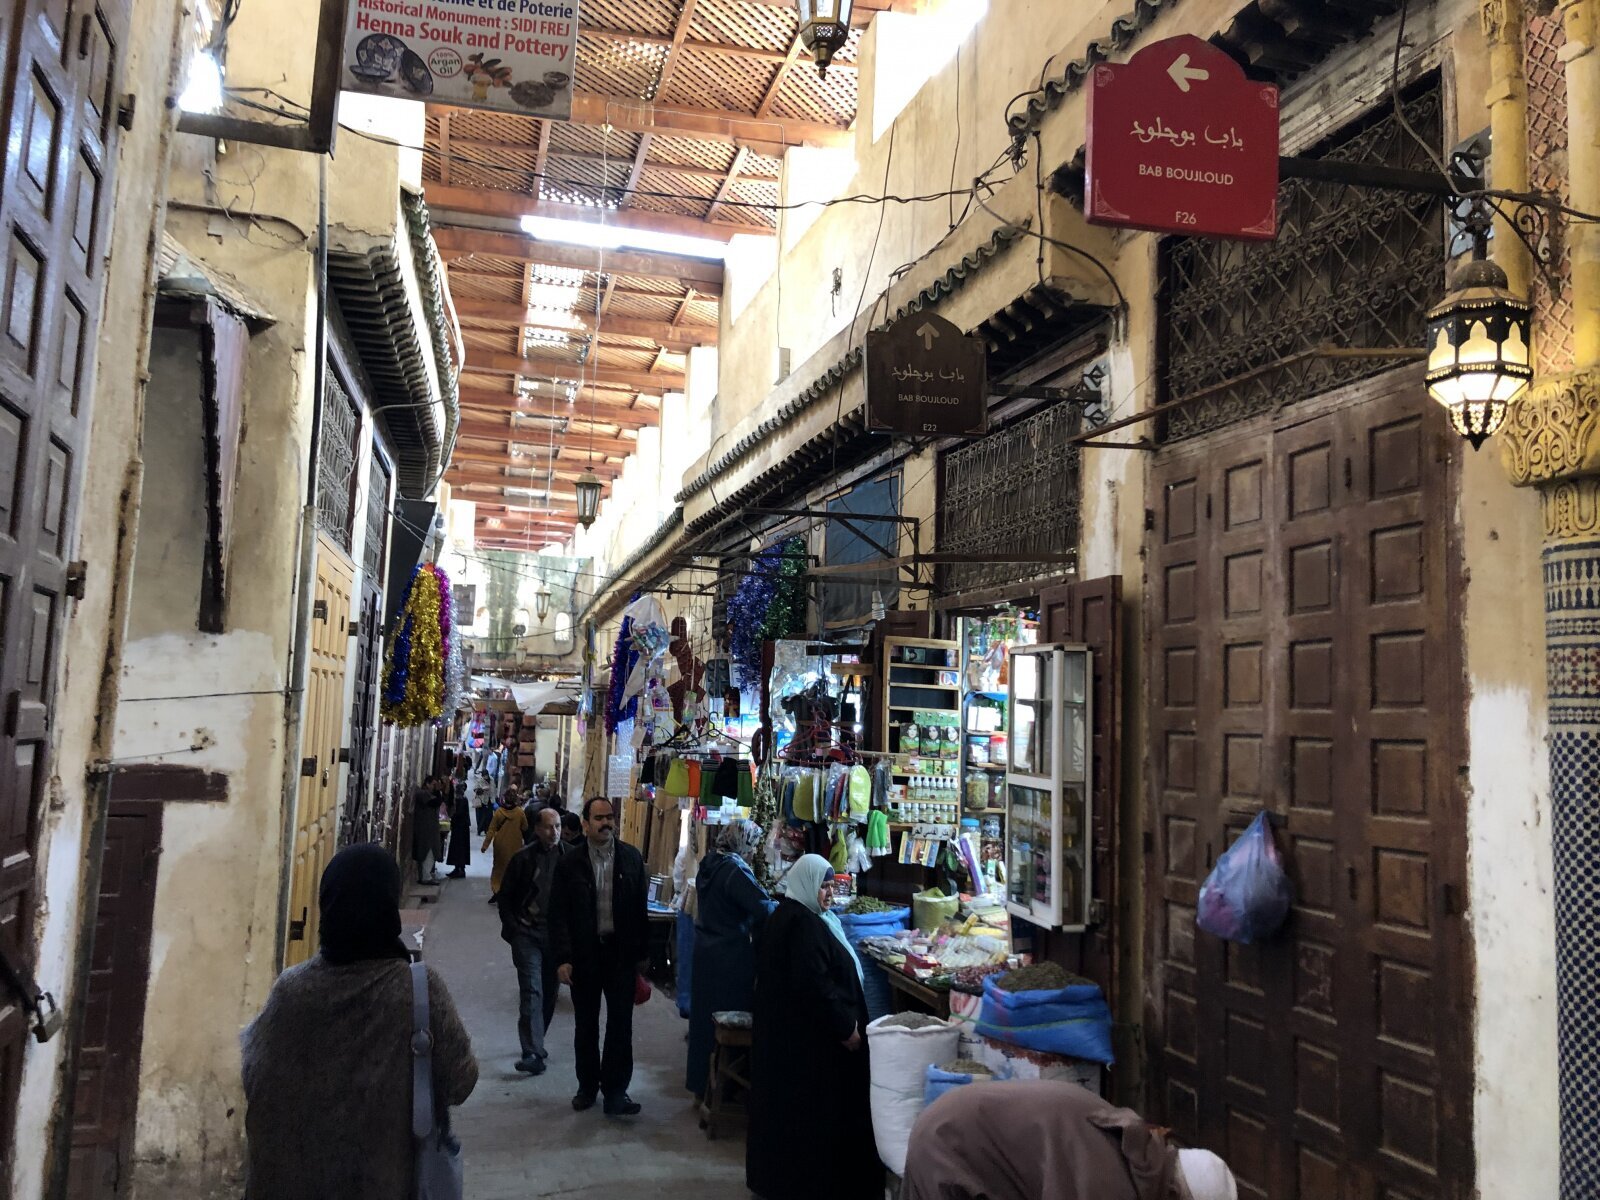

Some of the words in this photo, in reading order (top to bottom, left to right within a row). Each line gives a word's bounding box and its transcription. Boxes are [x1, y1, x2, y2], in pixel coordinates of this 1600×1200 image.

[358, 0, 423, 18] Historical
[425, 5, 501, 29] Monument
[511, 17, 537, 34] SIDI
[540, 21, 570, 37] FREJ
[478, 0, 494, 9] et
[497, 0, 516, 12] de
[519, 0, 573, 19] Poterie
[356, 11, 415, 37] Henna
[419, 21, 462, 44] Souk
[466, 32, 500, 50] and
[504, 33, 569, 62] Pottery
[431, 58, 460, 66] Argan
[439, 66, 453, 74] Oil
[1129, 116, 1196, 147] بوجلود
[1204, 125, 1244, 152] باب
[1138, 164, 1162, 177] BAB
[1166, 167, 1234, 185] BOUJLOUD
[1175, 211, 1197, 225] F26
[891, 363, 934, 383] بوجلود
[939, 367, 965, 384] باب
[898, 393, 914, 402] BAB
[915, 394, 960, 405] BOUJLOUD
